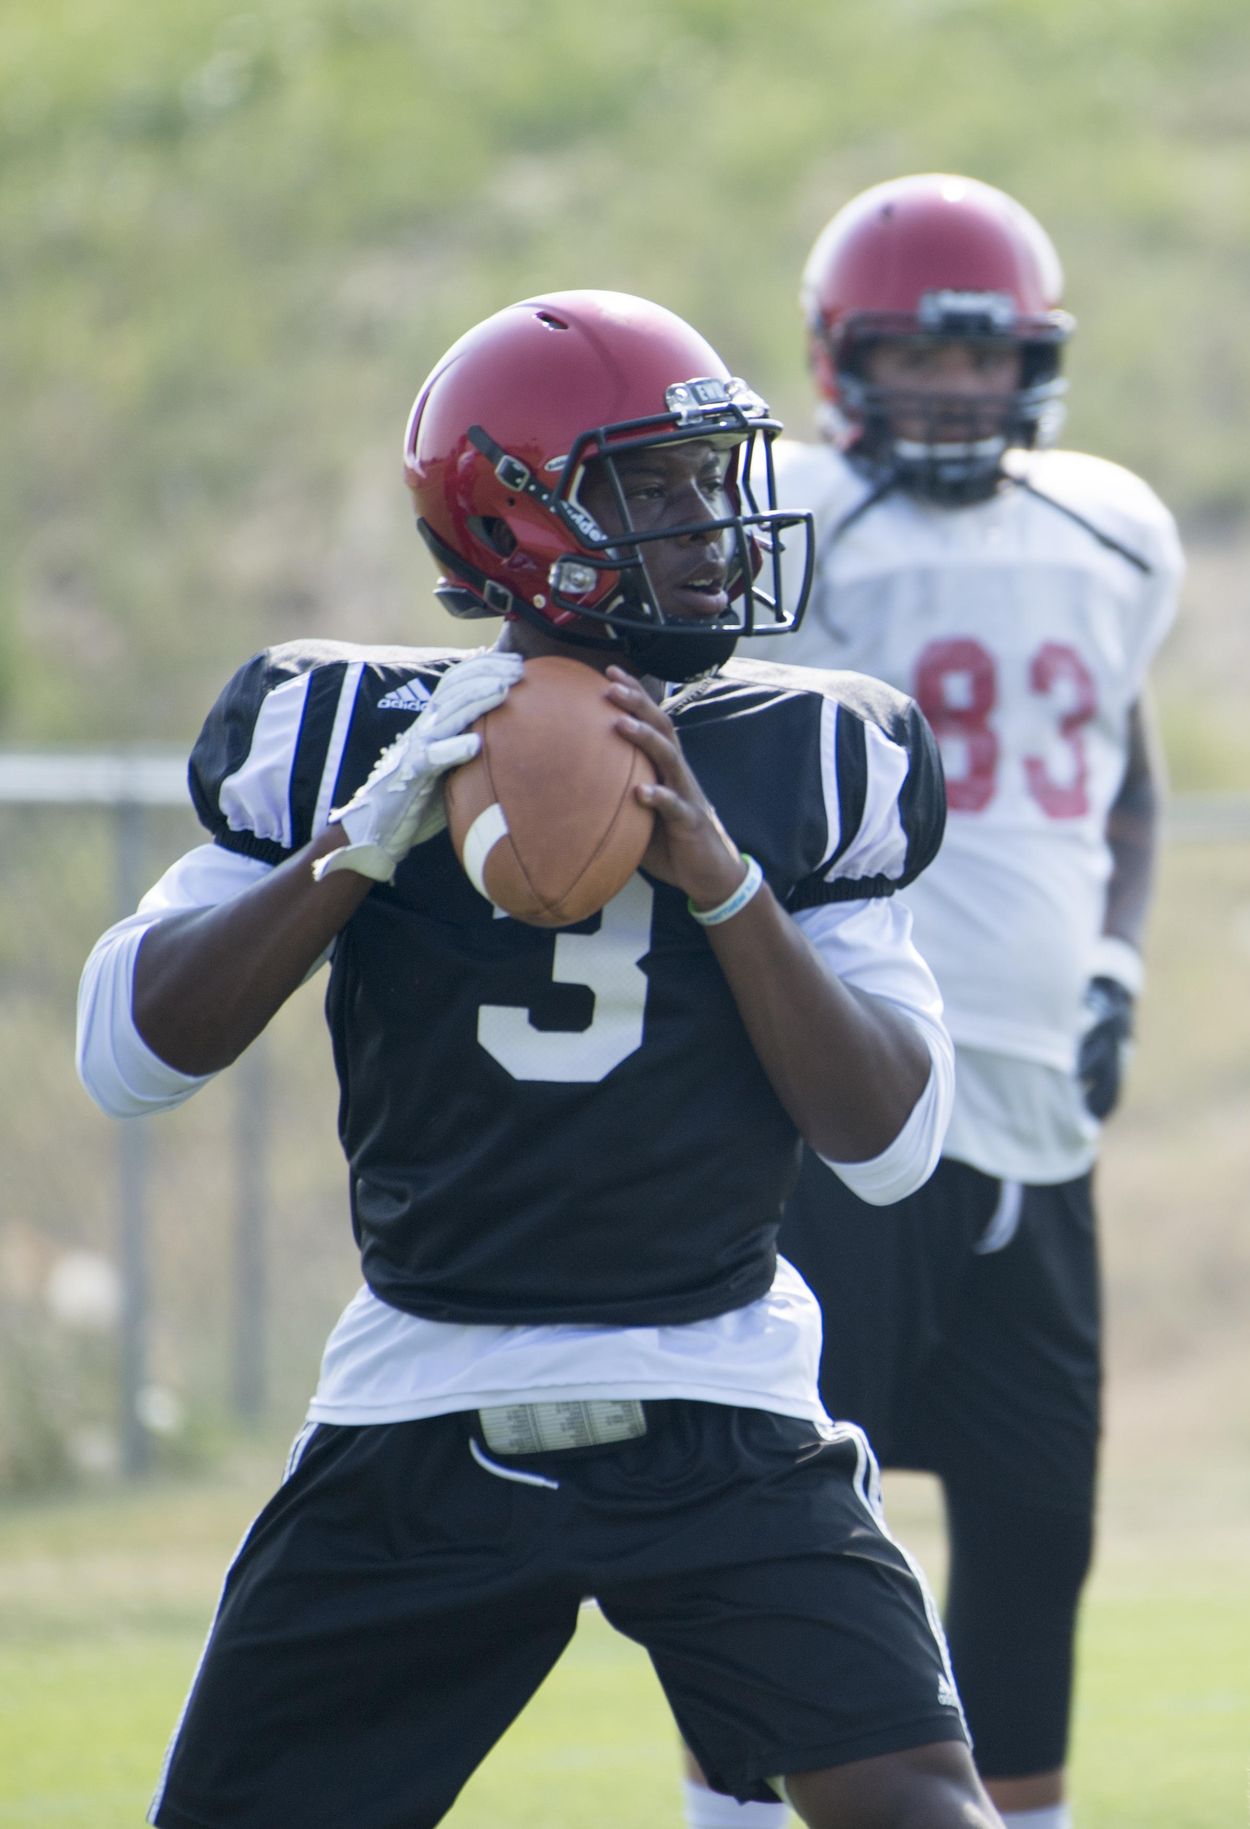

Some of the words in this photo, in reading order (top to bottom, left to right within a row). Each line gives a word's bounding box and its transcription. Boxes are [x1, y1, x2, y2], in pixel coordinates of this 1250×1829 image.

[377, 698, 429, 712] adid
[915, 635, 1098, 819] 83
[477, 871, 654, 1083] 3
